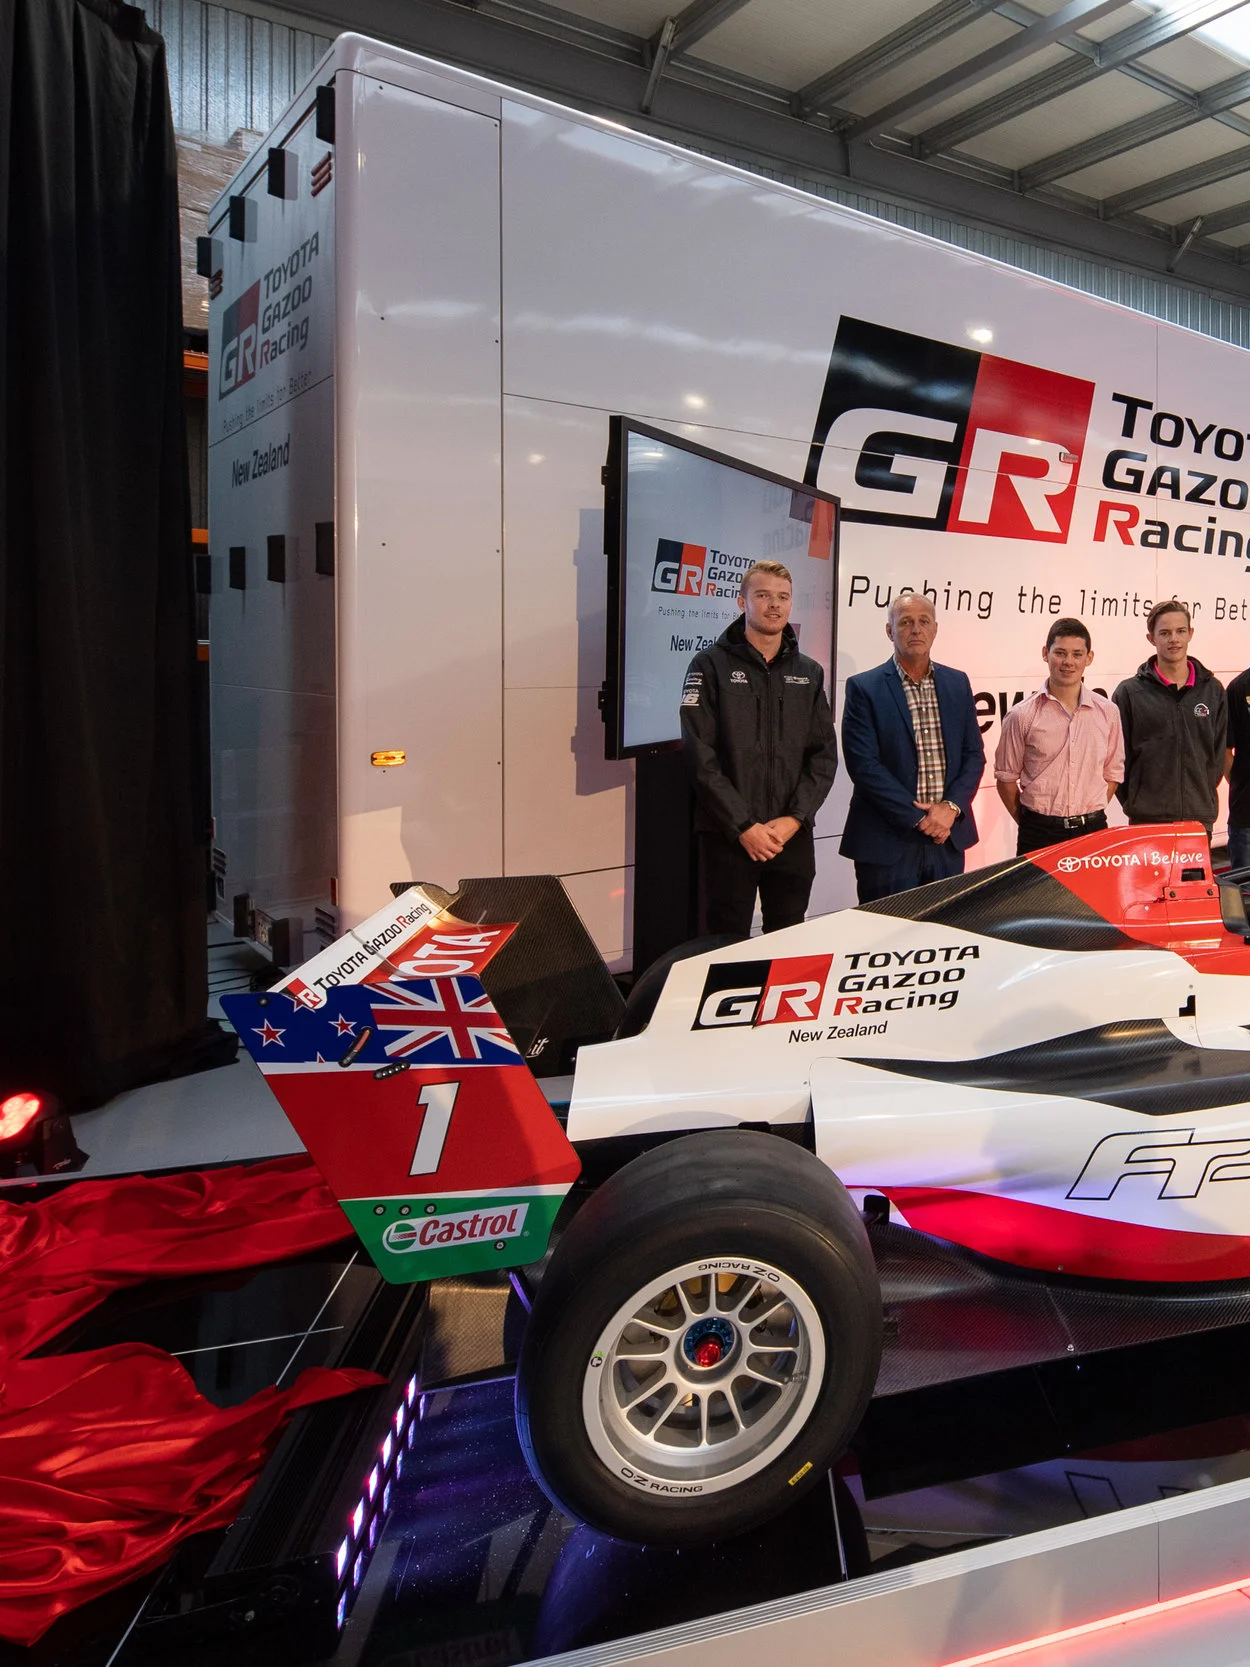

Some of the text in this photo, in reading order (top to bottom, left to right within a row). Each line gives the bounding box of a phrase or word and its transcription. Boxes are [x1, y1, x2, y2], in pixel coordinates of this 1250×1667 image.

[264, 231, 319, 299] TOYOTA
[262, 275, 312, 335] GAZOO
[260, 316, 309, 369] Racing
[221, 322, 257, 395] GR
[231, 433, 290, 488] New Zealand
[816, 407, 1074, 534] GR
[654, 561, 704, 594] GR
[707, 566, 743, 584] GAZO
[705, 582, 741, 599] Racin
[1018, 586, 1062, 615] the
[1080, 590, 1153, 618] limits
[658, 606, 685, 619] Pushing
[689, 609, 699, 618] the
[701, 610, 719, 619] limits
[670, 635, 693, 651] New
[1082, 851, 1205, 869] TOYOTA Believe
[313, 951, 369, 991] TOYOTA
[396, 903, 432, 929] Racing
[844, 945, 980, 970] TOYOTA
[838, 967, 966, 993] GAZOO
[833, 990, 959, 1016] Racing
[788, 1021, 888, 1044] New Zealand
[408, 1081, 461, 1177] 1
[419, 1208, 519, 1246] Castrol
[698, 1262, 750, 1271] RACING
[650, 1483, 703, 1493] RACING
